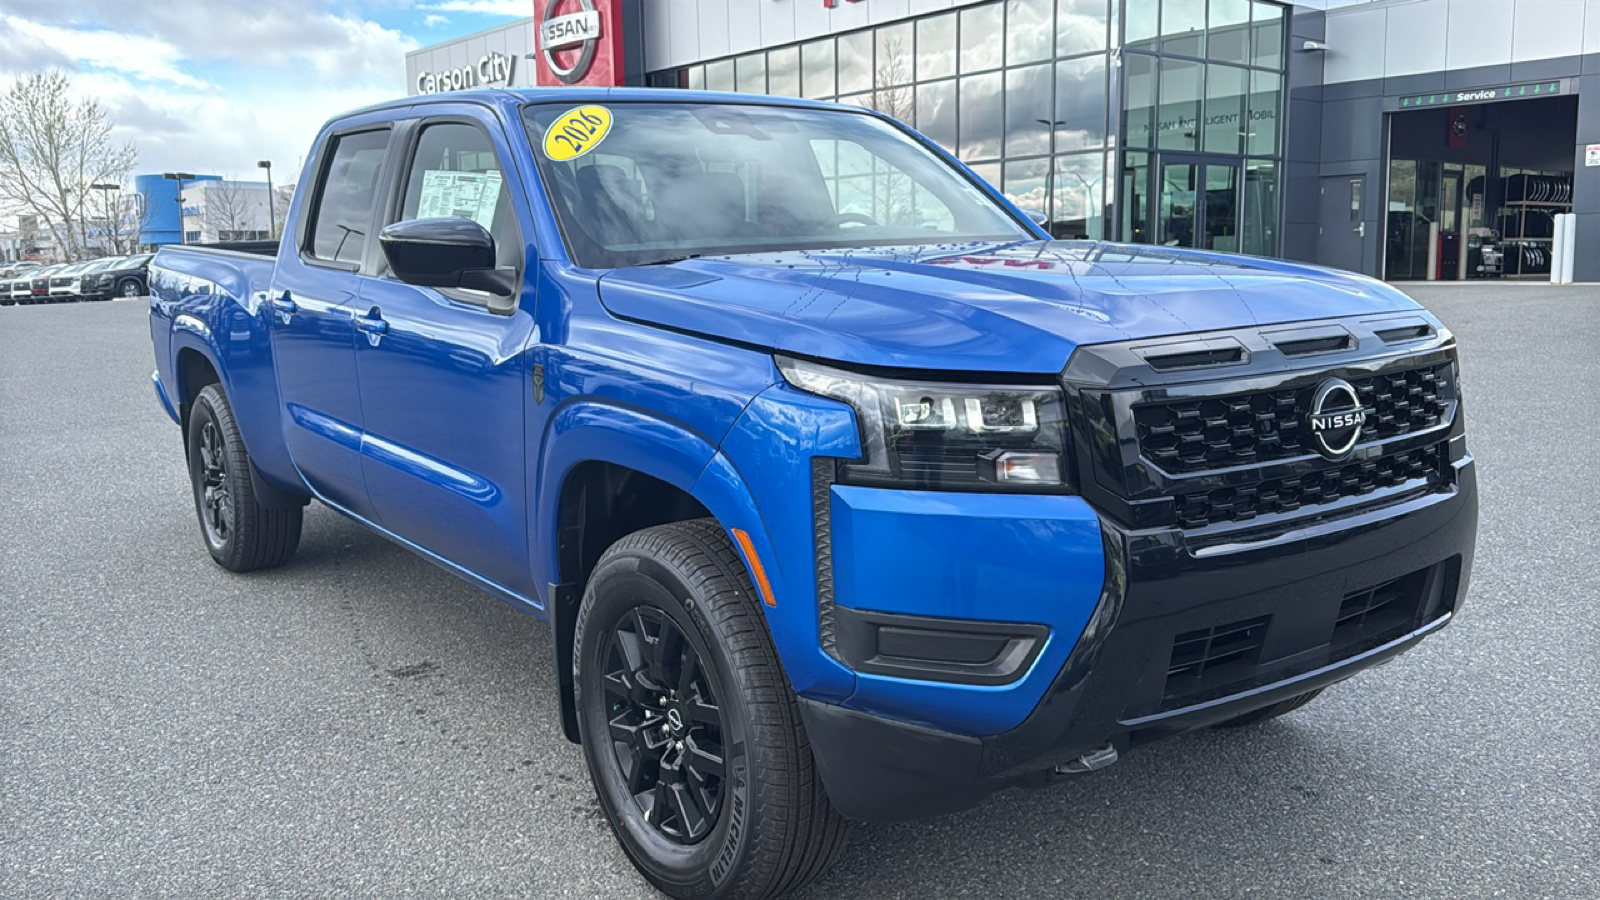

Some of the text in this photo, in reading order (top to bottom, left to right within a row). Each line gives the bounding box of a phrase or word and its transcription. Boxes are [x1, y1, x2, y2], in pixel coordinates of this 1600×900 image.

[417, 51, 516, 94] Carson City
[1456, 90, 1496, 101] Service
[554, 109, 603, 153] 2026
[712, 794, 743, 882] MICHELIN
